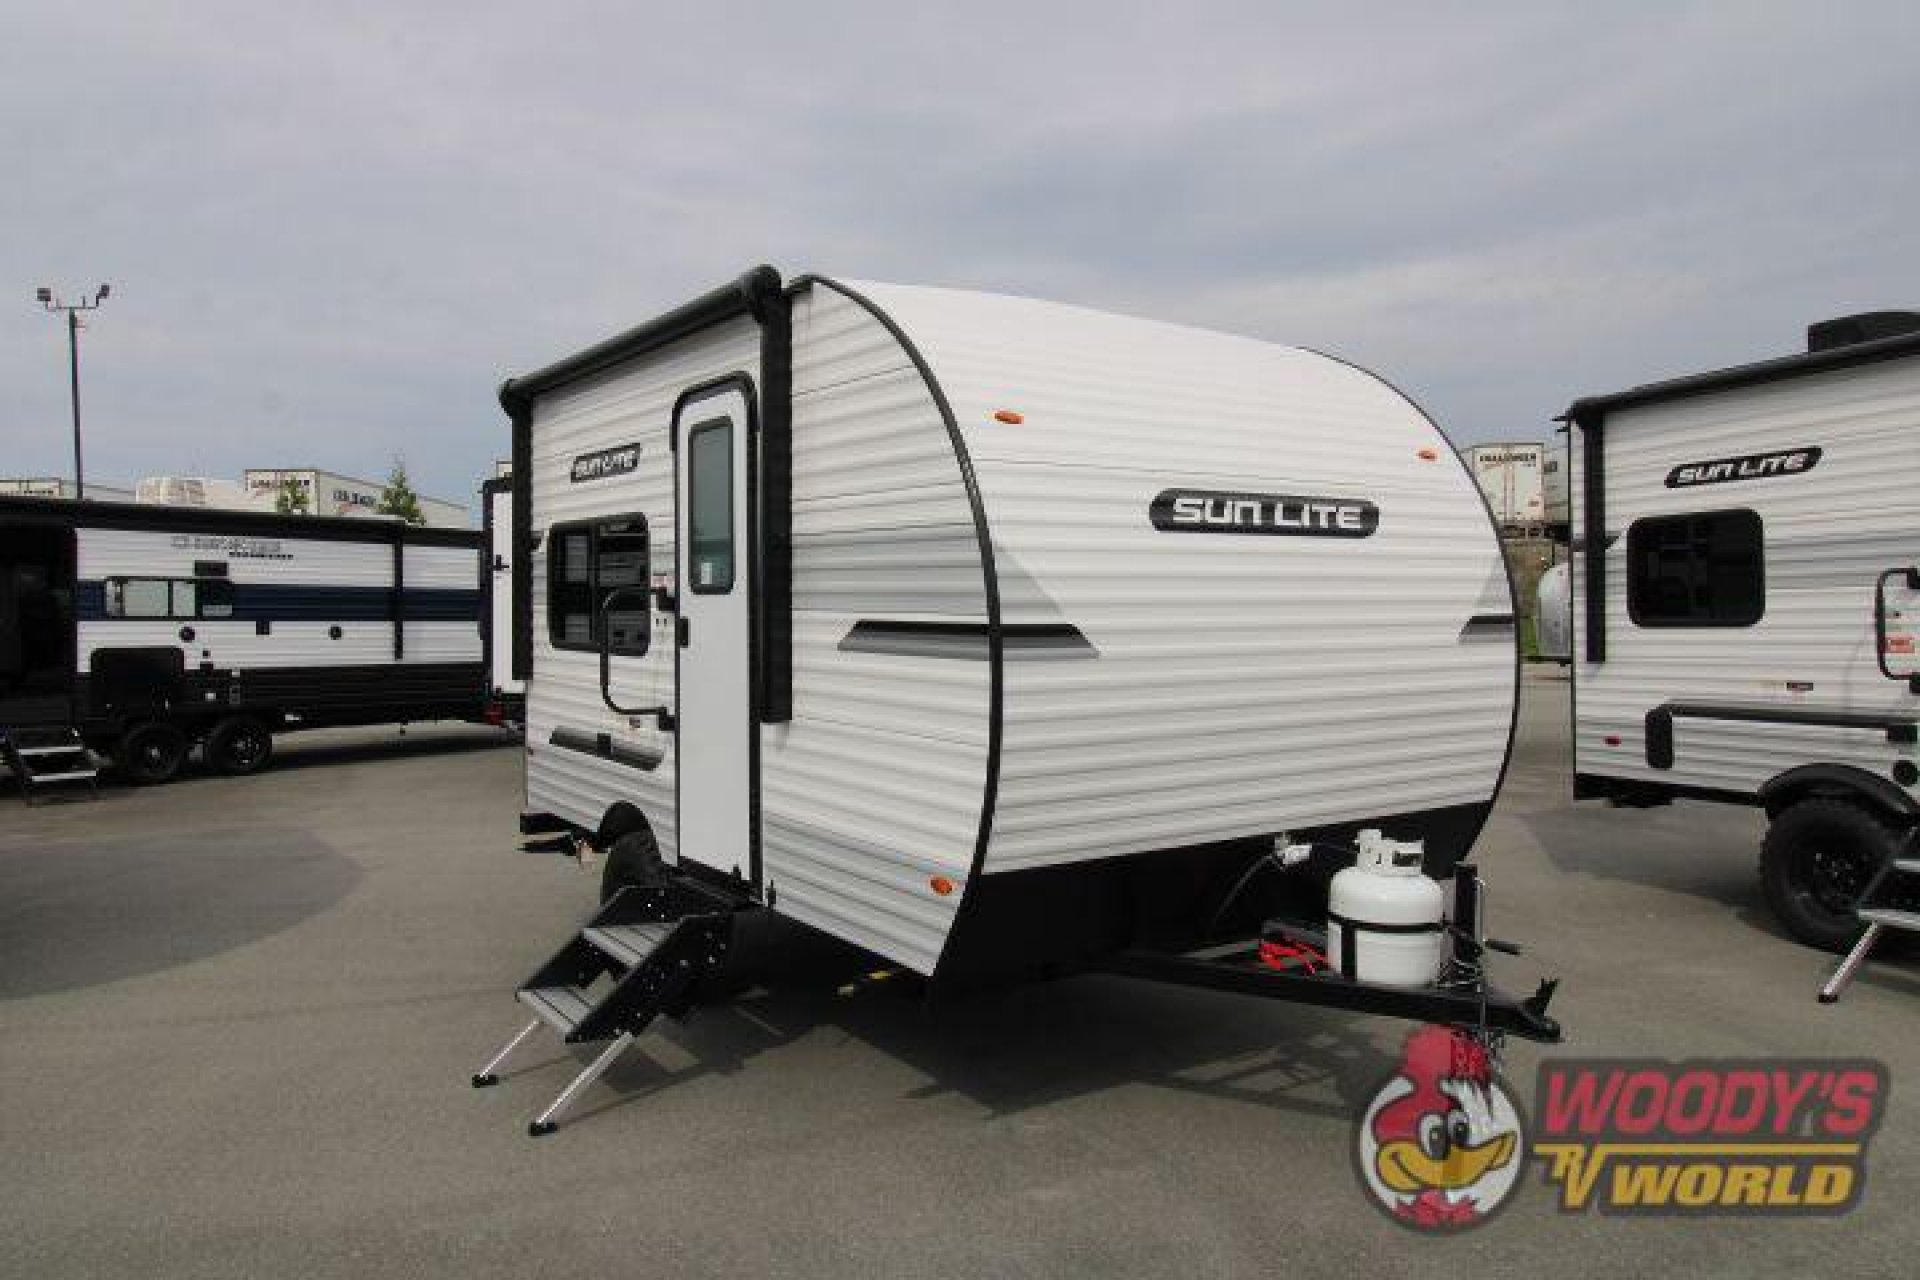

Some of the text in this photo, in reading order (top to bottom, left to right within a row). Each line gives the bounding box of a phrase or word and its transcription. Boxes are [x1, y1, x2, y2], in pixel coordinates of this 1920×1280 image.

[1677, 453, 1808, 483] SUN LITE
[1172, 498, 1363, 529] SUN LITE
